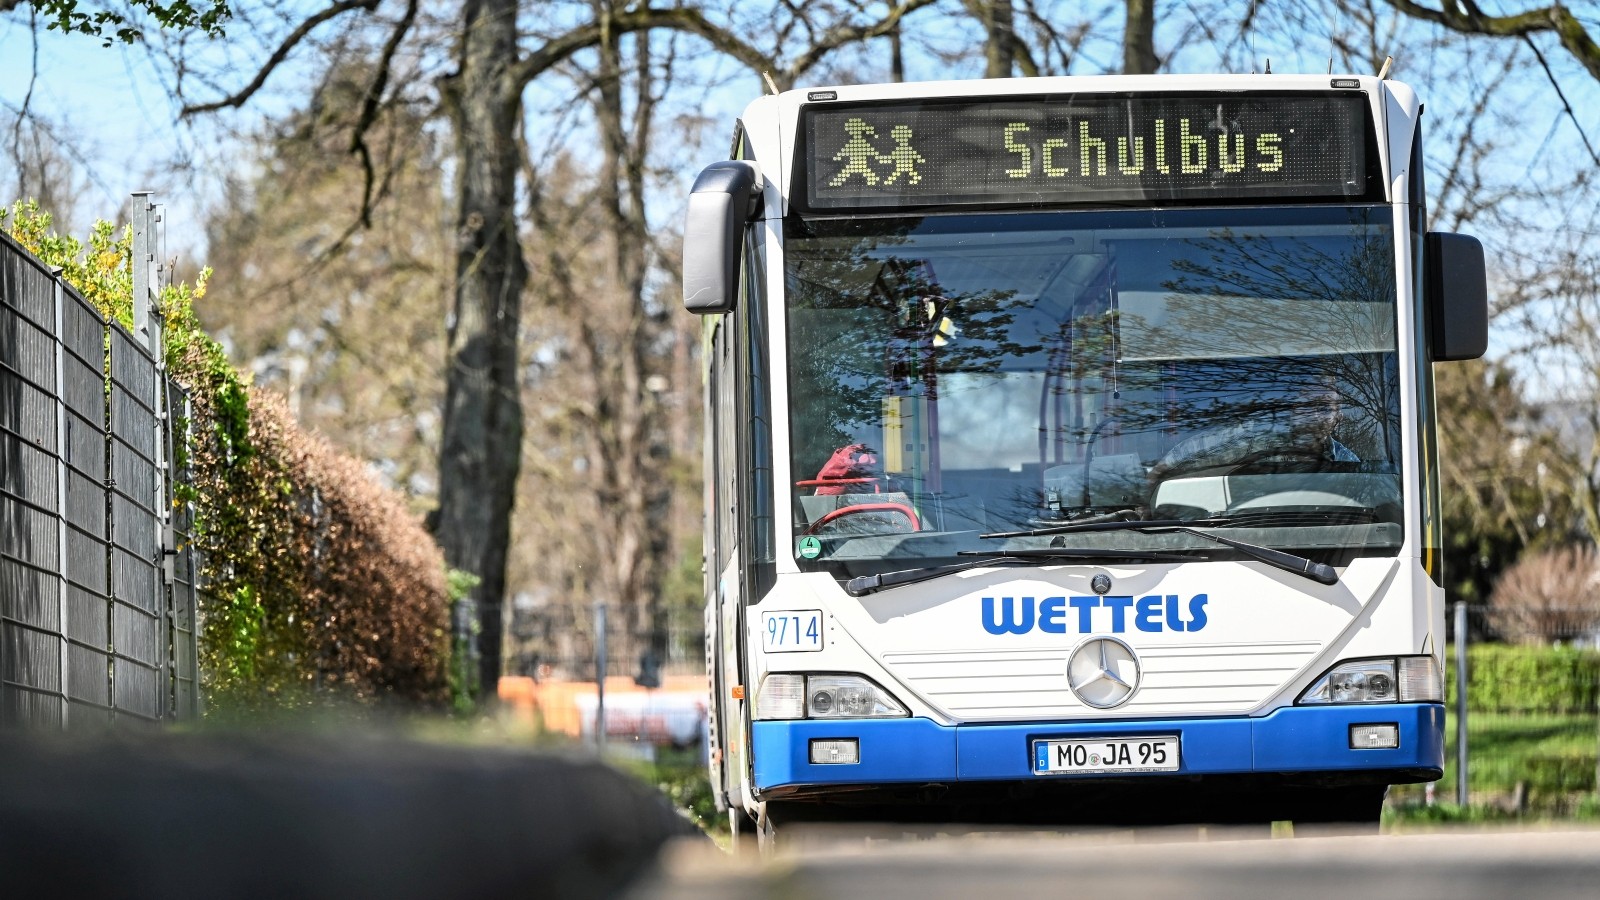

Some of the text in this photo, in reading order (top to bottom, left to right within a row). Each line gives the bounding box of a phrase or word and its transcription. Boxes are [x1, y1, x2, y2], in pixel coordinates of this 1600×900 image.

[1004, 118, 1283, 178] Schulbus
[806, 537, 814, 548] 4
[981, 593, 1208, 635] WETTELS
[768, 616, 819, 645] 9714
[1039, 759, 1045, 767] D
[1057, 742, 1166, 767] MO JA 95
